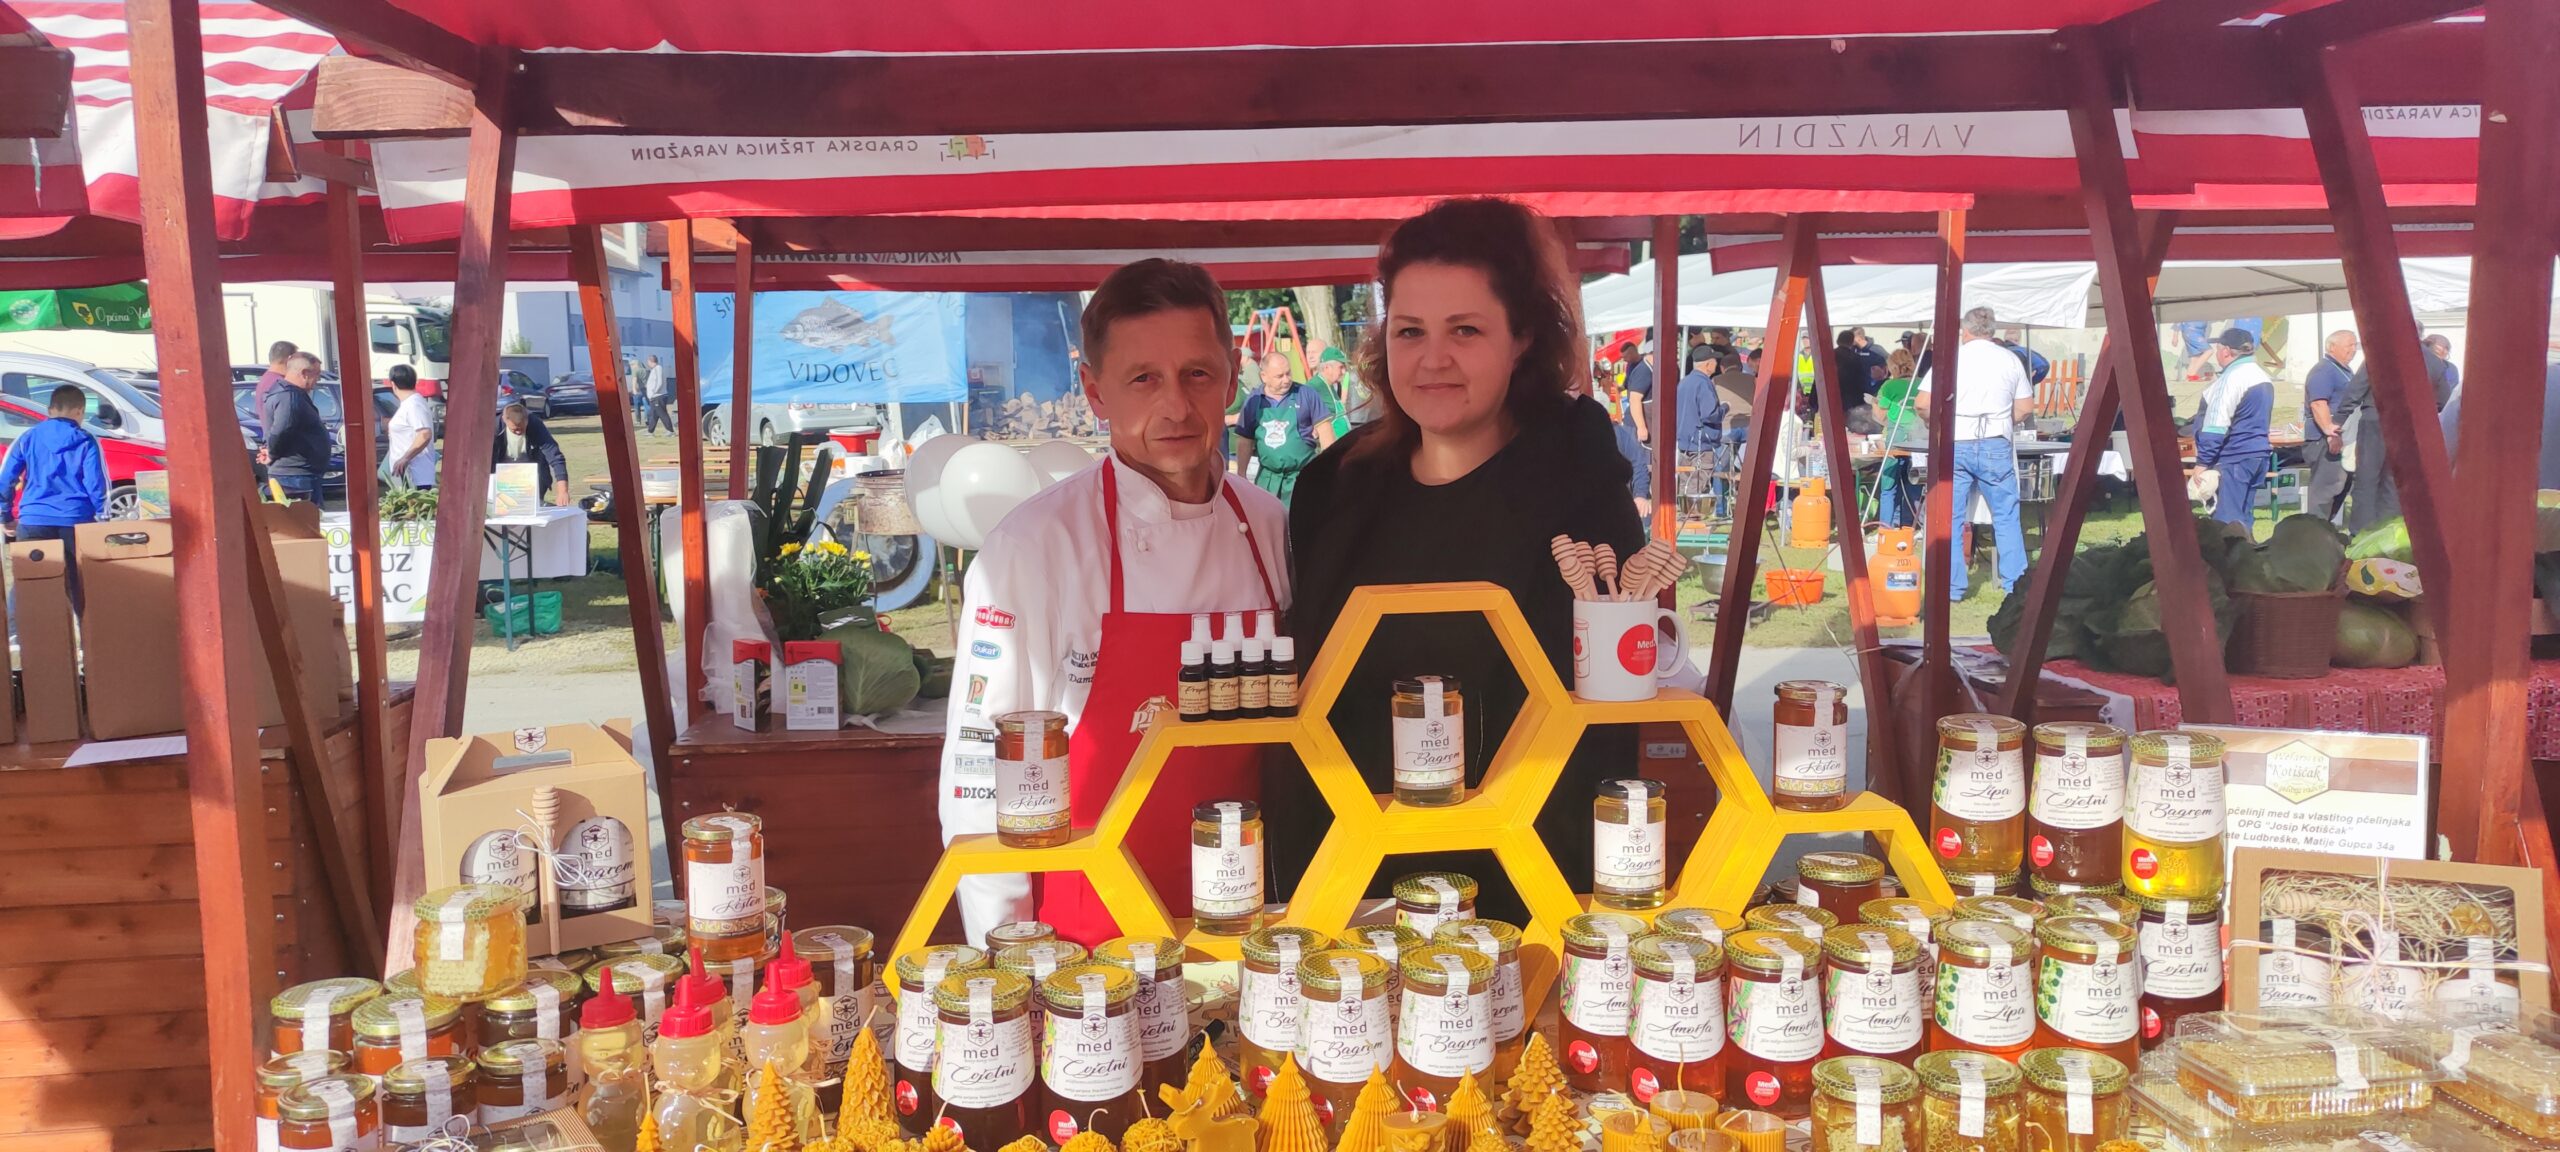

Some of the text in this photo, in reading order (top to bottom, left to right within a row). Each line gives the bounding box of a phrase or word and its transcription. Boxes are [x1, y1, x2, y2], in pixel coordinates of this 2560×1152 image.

[787, 357, 899, 384] VIDOVEC
[1421, 736, 1449, 748] med
[1808, 745, 1836, 757] med
[1971, 769, 2003, 781] med
[2058, 775, 2092, 788] med
[963, 786, 996, 799] DICK
[1018, 780, 1049, 792] med
[2160, 787, 2196, 799] med
[2238, 819, 2262, 829] OPG
[2267, 809, 2290, 819] med
[2293, 812, 2305, 820] sa
[2308, 811, 2354, 825] vlastitog
[2356, 814, 2411, 828] pčelinjaka
[1622, 843, 1651, 854] med
[2304, 838, 2335, 848] Matije
[2338, 838, 2372, 851] Gupca
[2375, 841, 2396, 851] 34a
[580, 846, 612, 861] med
[487, 855, 519, 871] med
[1216, 867, 1245, 878] med
[726, 879, 756, 895] med
[2158, 944, 2193, 955] med
[1918, 964, 1936, 975] ed
[2266, 973, 2301, 984] med
[1491, 985, 1505, 998] ed
[1984, 987, 2018, 1000] med
[2088, 986, 2122, 997] med
[1274, 994, 1297, 1006] me
[1862, 994, 1897, 1007] med
[1664, 1002, 1699, 1016] med
[1776, 1002, 1808, 1015] med
[831, 1016, 860, 1032] med
[1333, 1020, 1367, 1036] med
[1440, 1016, 1473, 1030] med
[963, 1044, 999, 1059] med
[1077, 1038, 1112, 1053] med
